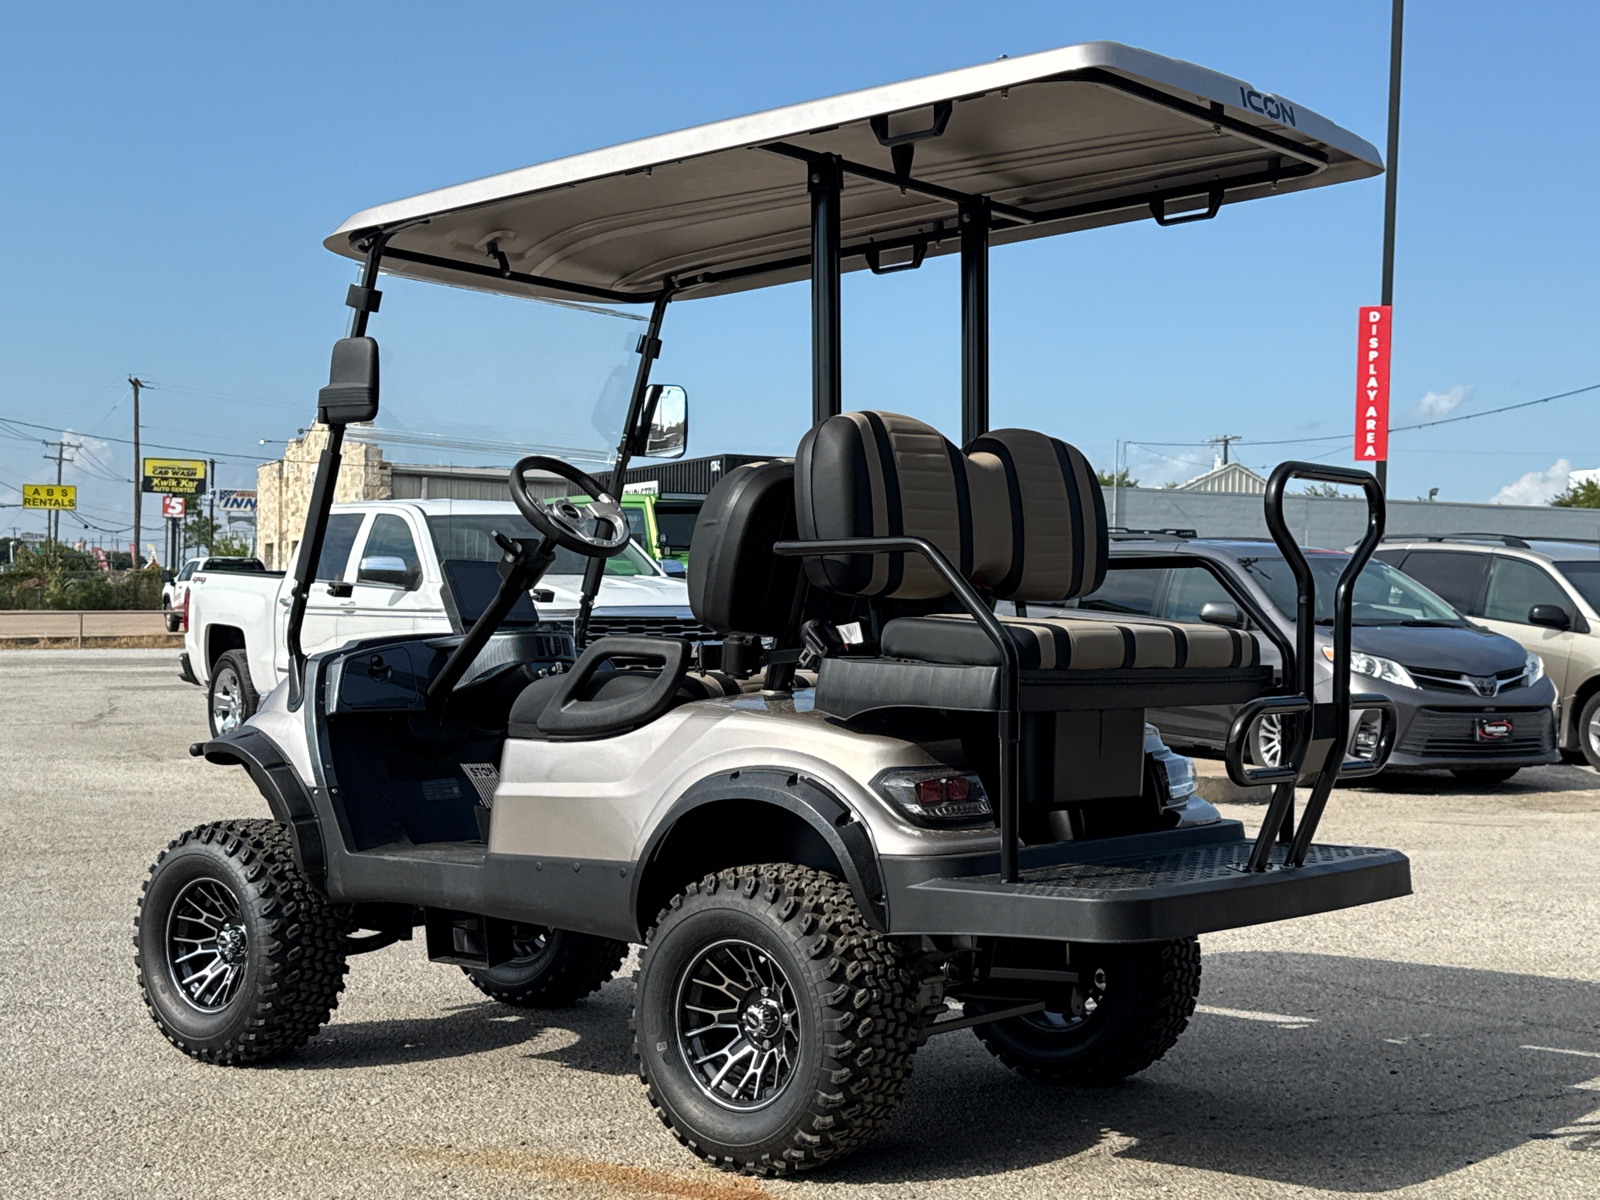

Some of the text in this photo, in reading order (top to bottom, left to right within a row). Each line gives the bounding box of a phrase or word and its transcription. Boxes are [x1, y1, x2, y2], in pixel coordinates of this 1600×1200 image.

[1239, 86, 1296, 127] ICON
[1364, 311, 1381, 457] DISPLAY AREA
[151, 477, 199, 488] Kwik Kar
[24, 498, 75, 507] RENTALS
[223, 497, 257, 508] INN
[469, 767, 493, 777] STOP
